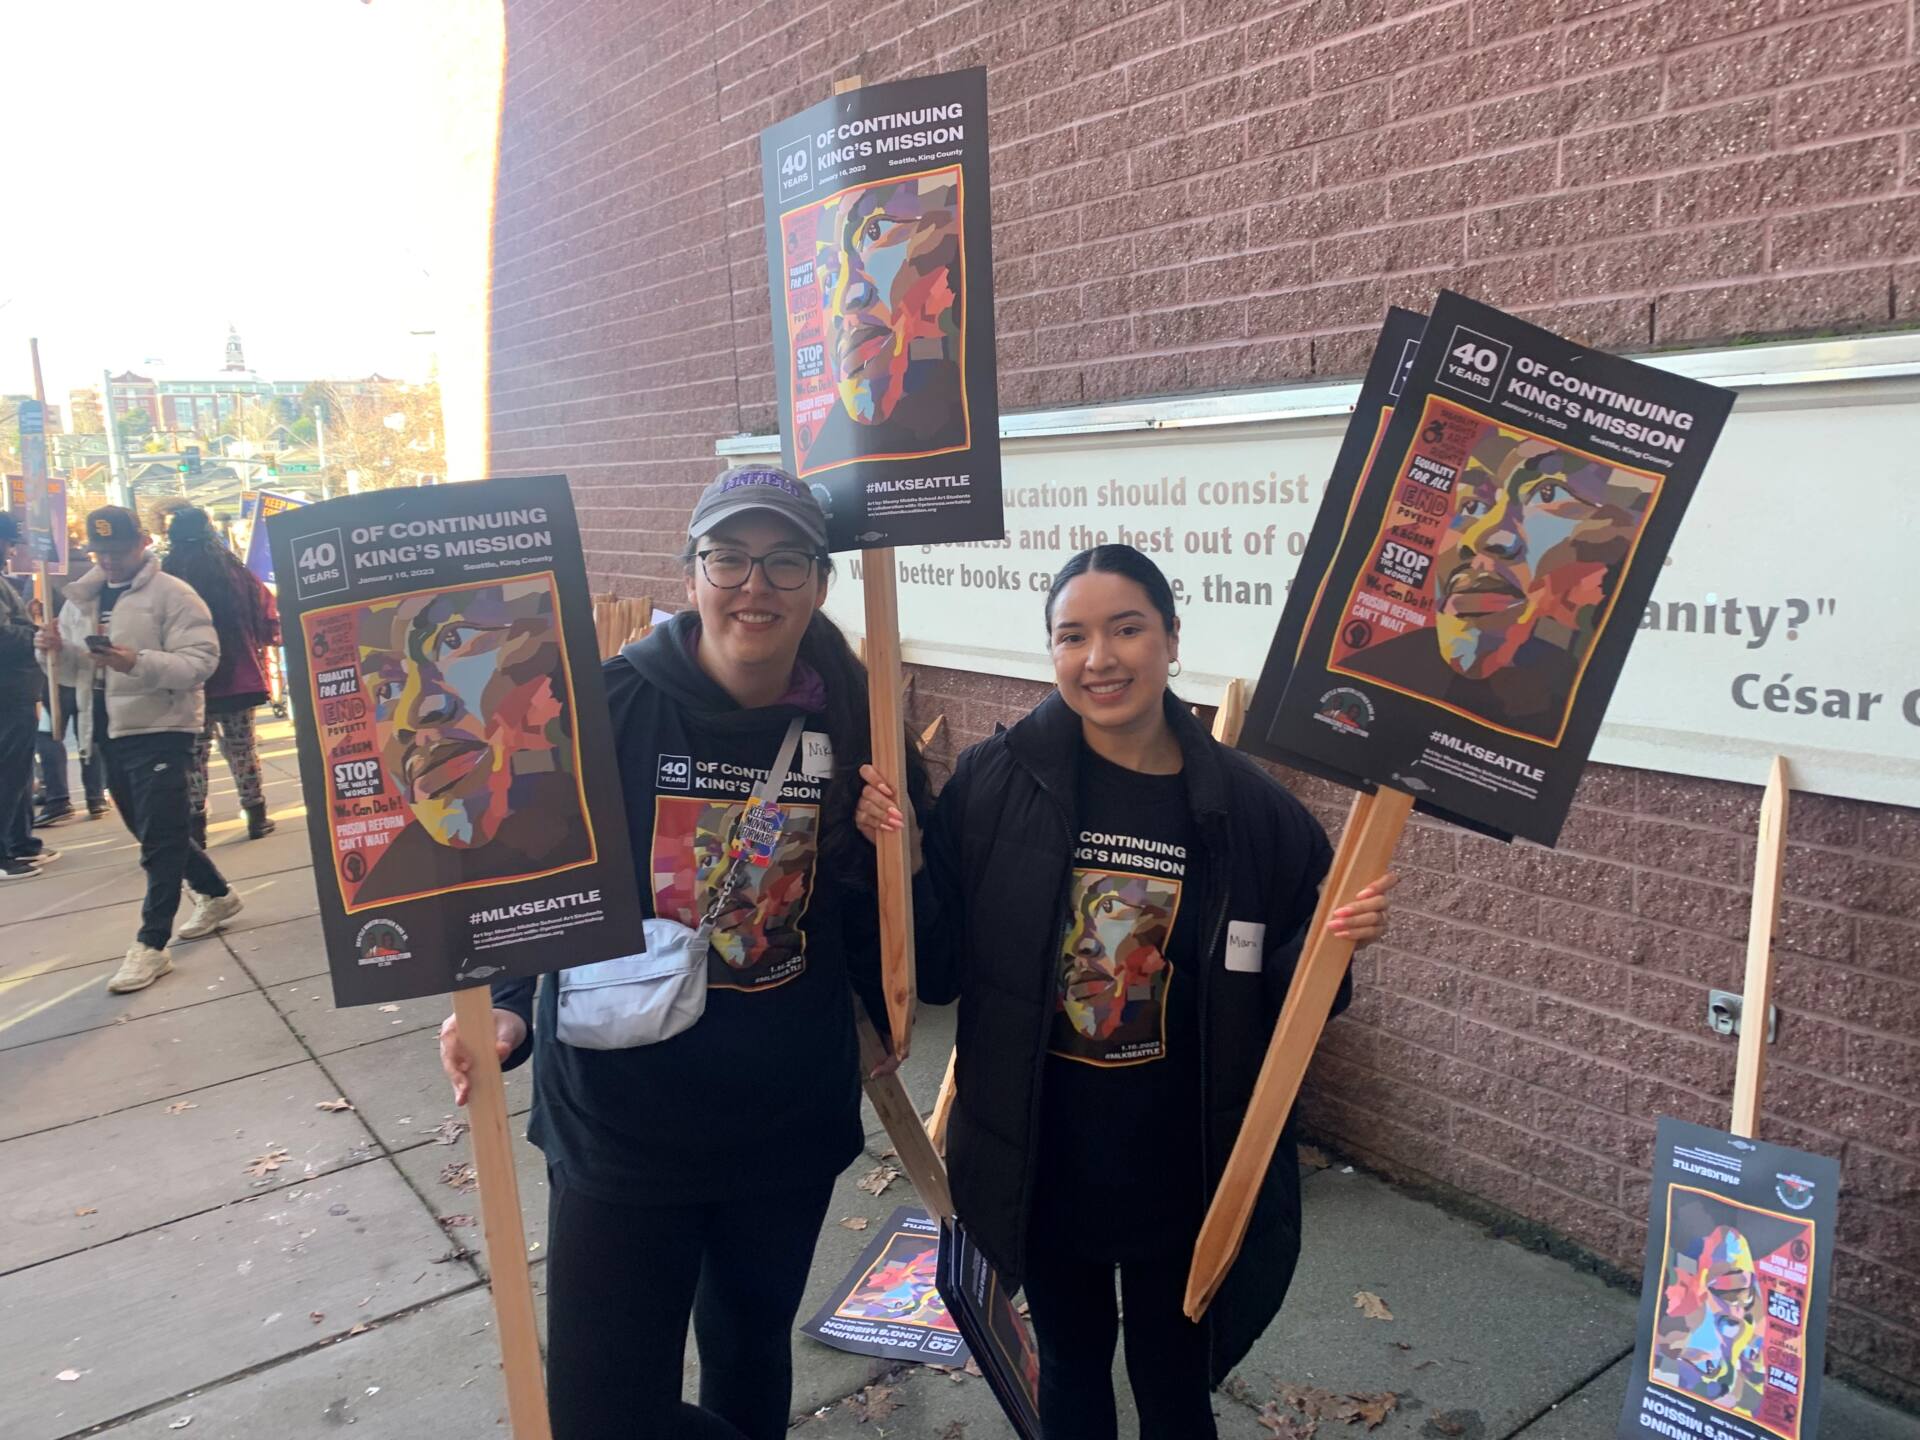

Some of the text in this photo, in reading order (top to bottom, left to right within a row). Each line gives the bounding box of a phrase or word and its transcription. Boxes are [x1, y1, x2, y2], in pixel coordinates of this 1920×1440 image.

[816, 103, 963, 149] OF CONTINUING
[818, 125, 964, 171] KING'S MISSION
[888, 148, 964, 167] Seattle, King County
[781, 150, 807, 176] 40
[782, 173, 809, 189] YEARS
[797, 344, 823, 365] STOP
[1452, 342, 1498, 373] 40
[1448, 363, 1491, 388] YEARS
[1516, 356, 1694, 430] OF CONTINUING
[1502, 399, 1533, 418] January
[1507, 377, 1686, 453] KING'S MISSION
[1589, 434, 1675, 468] Seattle, King County
[1414, 456, 1456, 479] EQUALITY
[865, 474, 970, 494] #MLKSEATTLE
[1003, 481, 1088, 508] ucation
[1097, 477, 1187, 507] should
[1198, 471, 1309, 506] consist
[1408, 468, 1451, 492] FOR ALL
[1401, 484, 1449, 517] END
[351, 507, 547, 544] OF CONTINUING
[354, 531, 552, 569] KING'S MISSION
[1019, 525, 1060, 550] and
[1069, 525, 1109, 552] the
[1118, 525, 1174, 553] best
[1184, 526, 1232, 554] out
[1244, 524, 1277, 555] of
[299, 543, 336, 570] 40
[464, 554, 553, 571] Seattle, King County
[1382, 541, 1430, 572] STOP
[302, 569, 339, 585] YEARS
[358, 574, 393, 585] January
[411, 568, 435, 578] 2023
[899, 561, 955, 586] better
[961, 564, 1021, 591] books
[1029, 572, 1056, 593] ca
[1172, 577, 1192, 606] e,
[1203, 574, 1272, 606] than
[1383, 568, 1414, 585] WOMEN
[1384, 583, 1403, 600] Can
[1379, 615, 1407, 633] WAIT
[1640, 597, 1836, 650] anity?"
[320, 680, 357, 698] FOR ALL
[1731, 673, 1883, 721] César
[324, 698, 366, 726] END
[327, 721, 367, 737] POVERTY
[1429, 730, 1546, 783] #MLKSEATTLE
[334, 760, 378, 782] STOP
[660, 762, 687, 775] 40
[660, 776, 687, 784] YEARS
[695, 761, 820, 784] OF CONTIUING
[336, 782, 350, 790] THE
[351, 780, 368, 788] WAR
[344, 787, 374, 797] WOMEN
[695, 777, 751, 793] KING'S
[352, 803, 372, 816] Can
[367, 815, 405, 832] REFORM
[1080, 831, 1186, 859] CONTINUING
[1111, 852, 1185, 876] MISSION
[469, 889, 601, 925] #MLKSEATTLE
[1673, 1159, 1740, 1185] #MLKSEATTLE
[1769, 1304, 1799, 1325] STOP
[819, 1326, 898, 1346] CONTINUING
[824, 1320, 879, 1336] MISSION
[879, 1328, 923, 1341] KING'S
[928, 1341, 956, 1352] 40
[1642, 1397, 1701, 1433] MISSION
